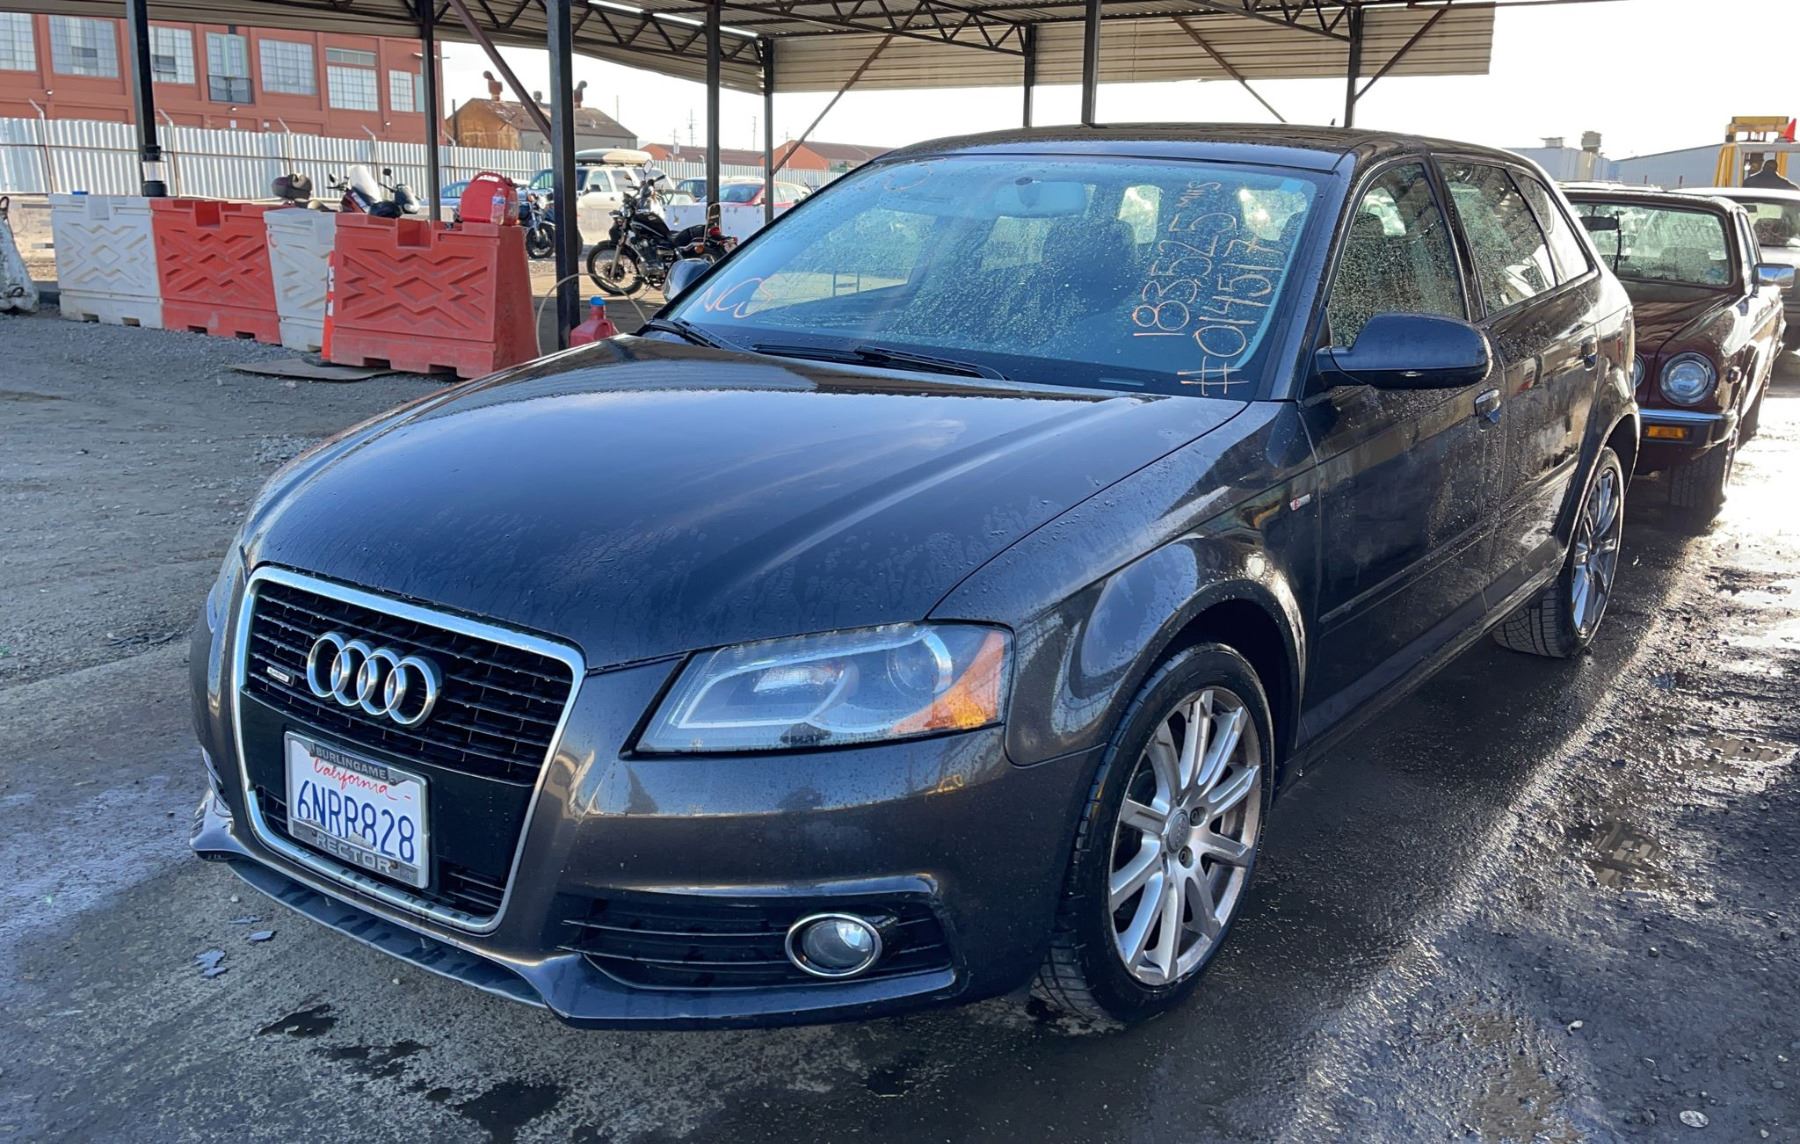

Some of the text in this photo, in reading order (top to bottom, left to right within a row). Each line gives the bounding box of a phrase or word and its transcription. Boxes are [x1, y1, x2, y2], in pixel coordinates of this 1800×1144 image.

[313, 758, 399, 800] California
[315, 747, 387, 779] BURLINGAME
[297, 780, 416, 863] 6NRR828
[314, 833, 392, 873] RECTOR
